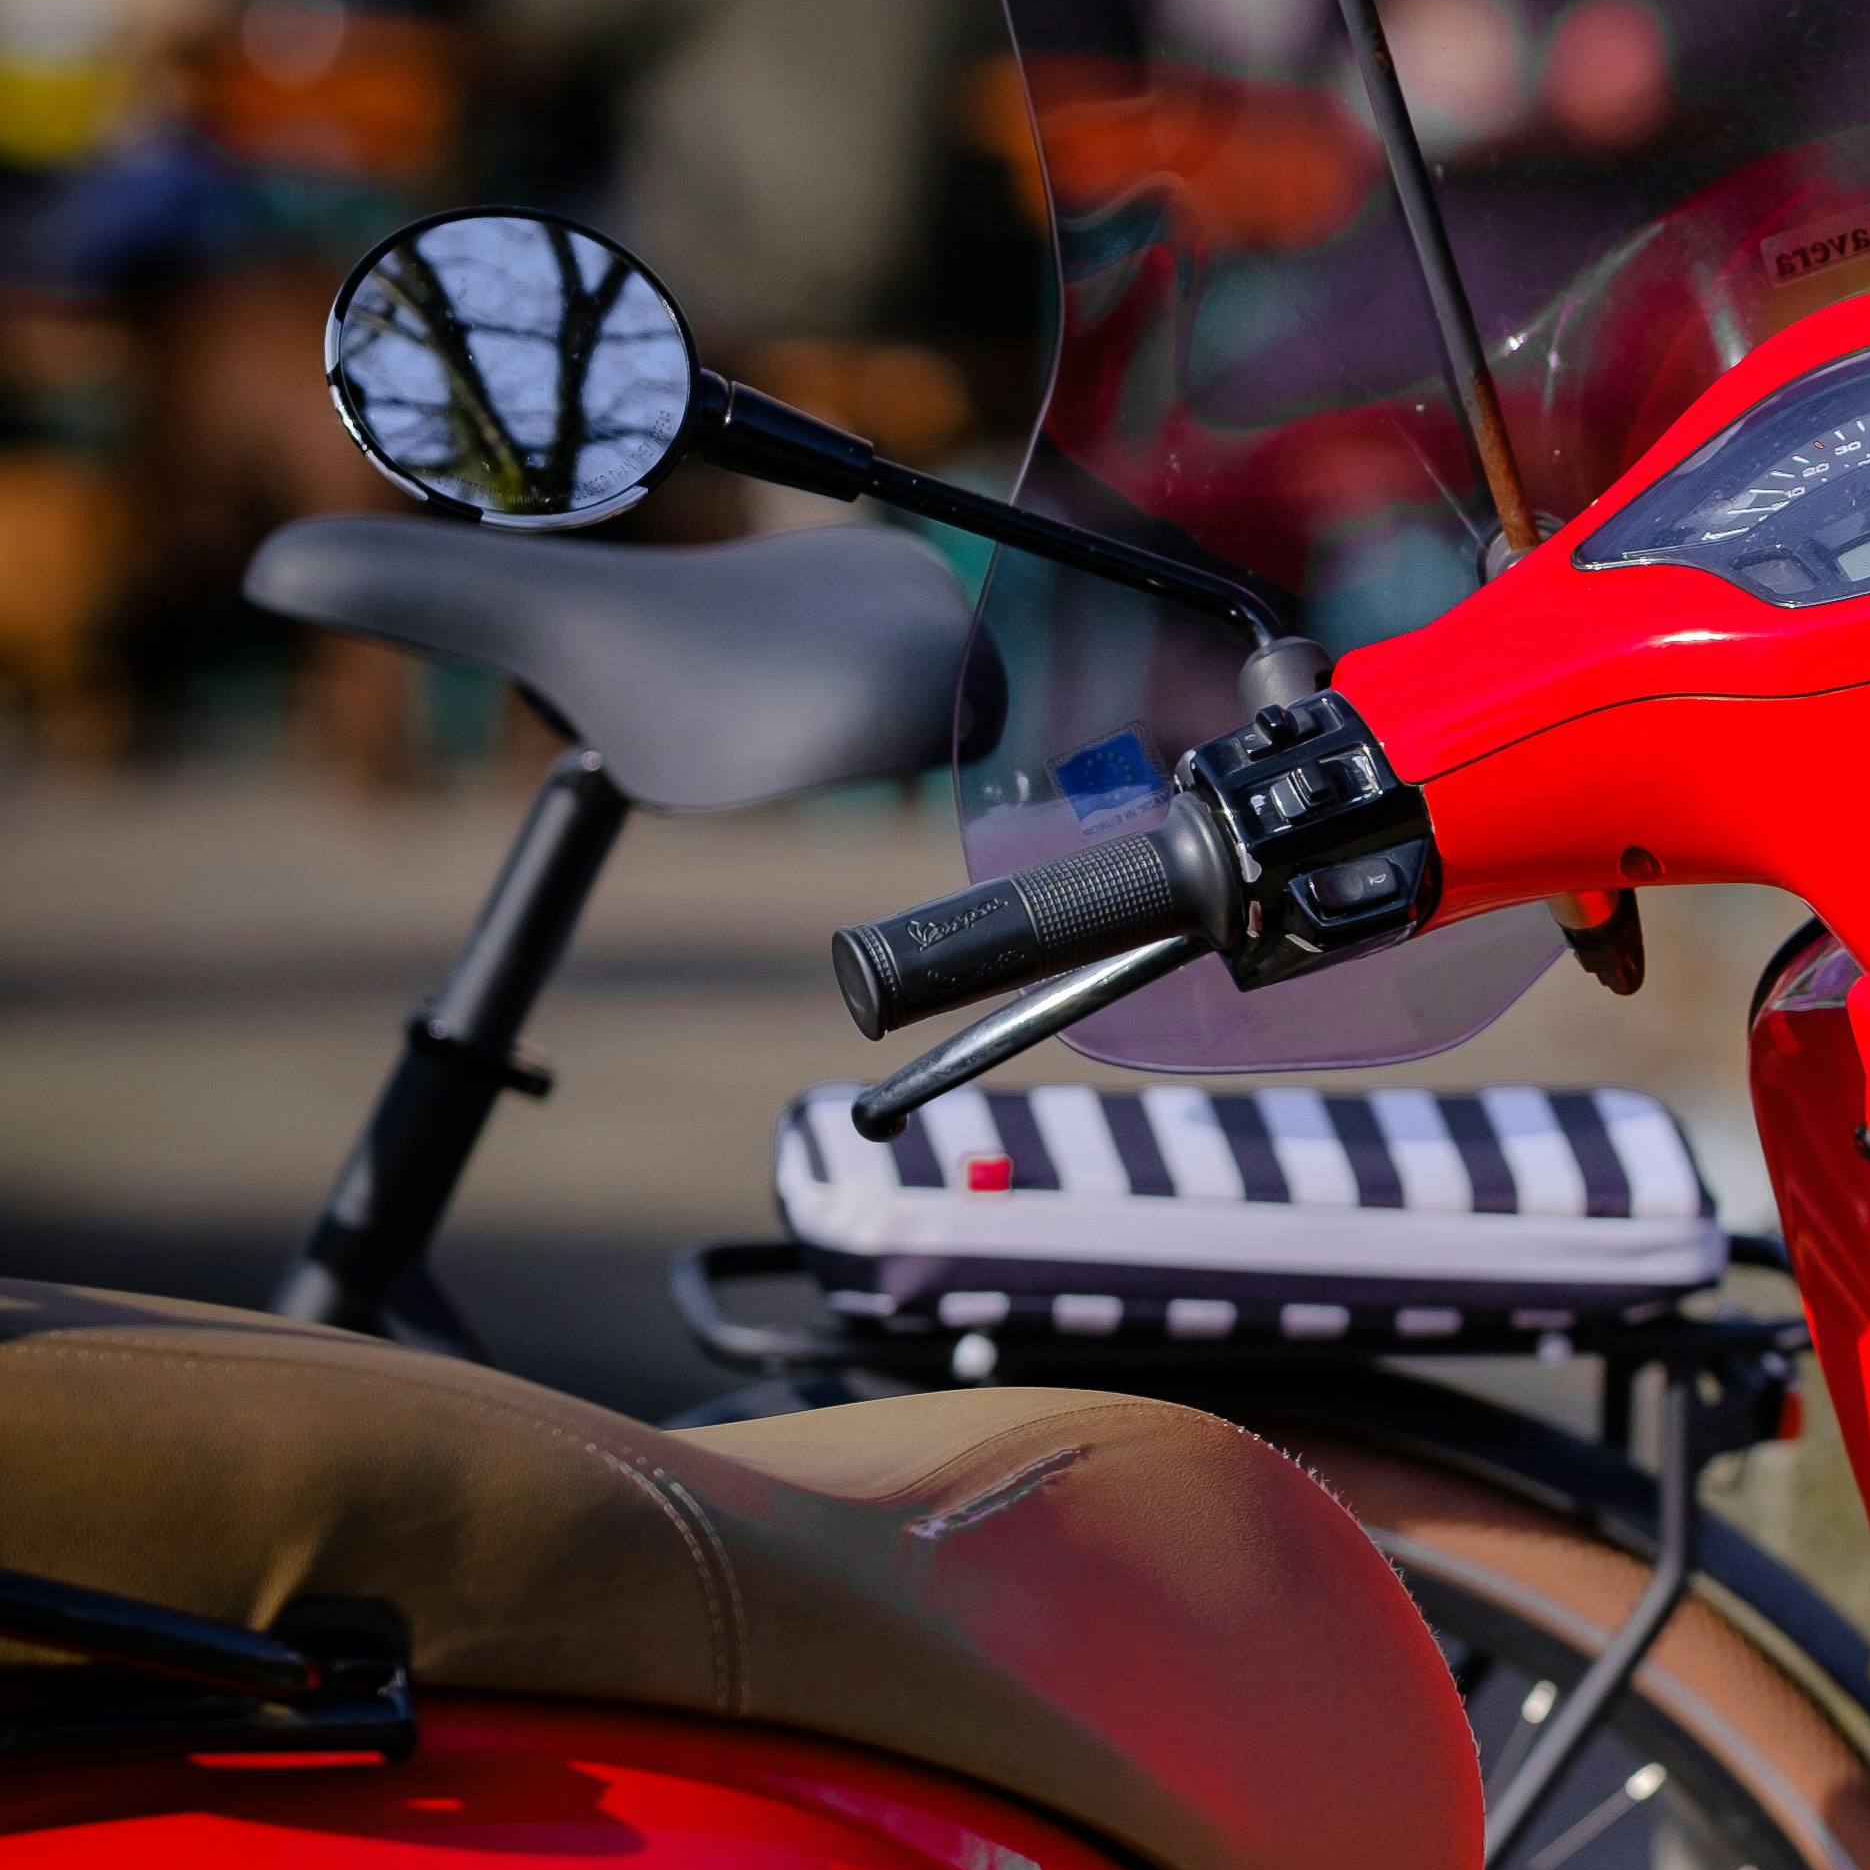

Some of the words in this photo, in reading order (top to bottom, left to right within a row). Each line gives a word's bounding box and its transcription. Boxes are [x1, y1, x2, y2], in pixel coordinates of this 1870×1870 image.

[1801, 462, 1830, 478] 20
[1834, 441, 1862, 456] 30
[907, 897, 1010, 953] Vespa
